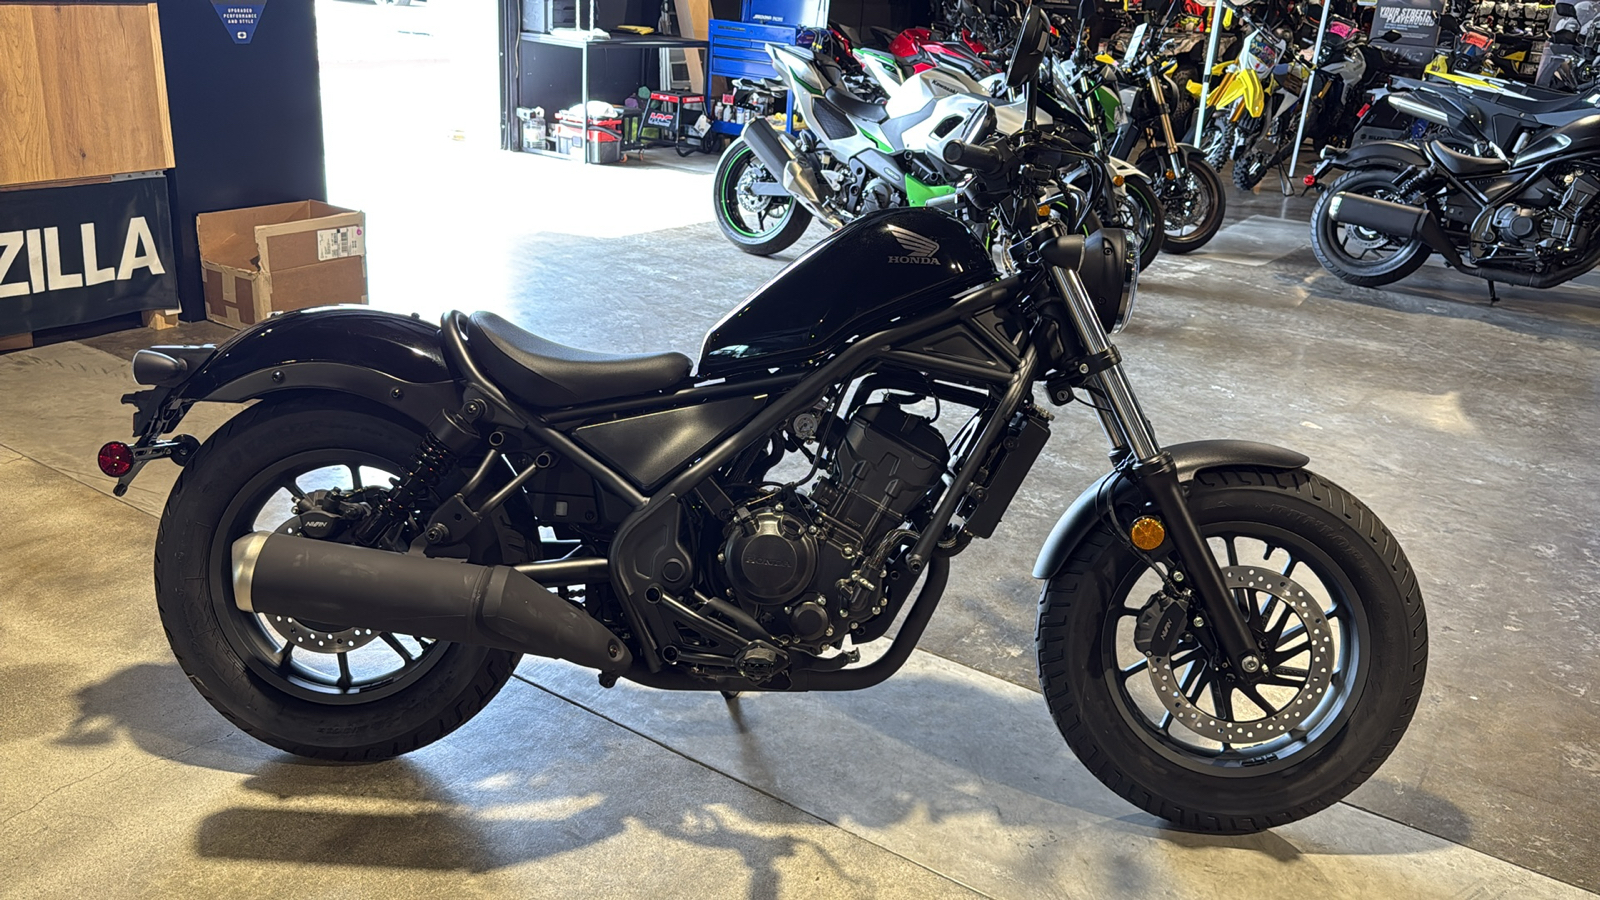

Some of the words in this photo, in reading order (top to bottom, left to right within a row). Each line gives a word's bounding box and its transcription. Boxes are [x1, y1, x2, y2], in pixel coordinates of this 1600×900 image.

[1380, 6, 1401, 18] YOUR
[1386, 14, 1435, 26] PLAYGROUND
[0, 216, 166, 298] ZILLA
[888, 255, 941, 265] HONDA
[745, 556, 793, 568] HONDA
